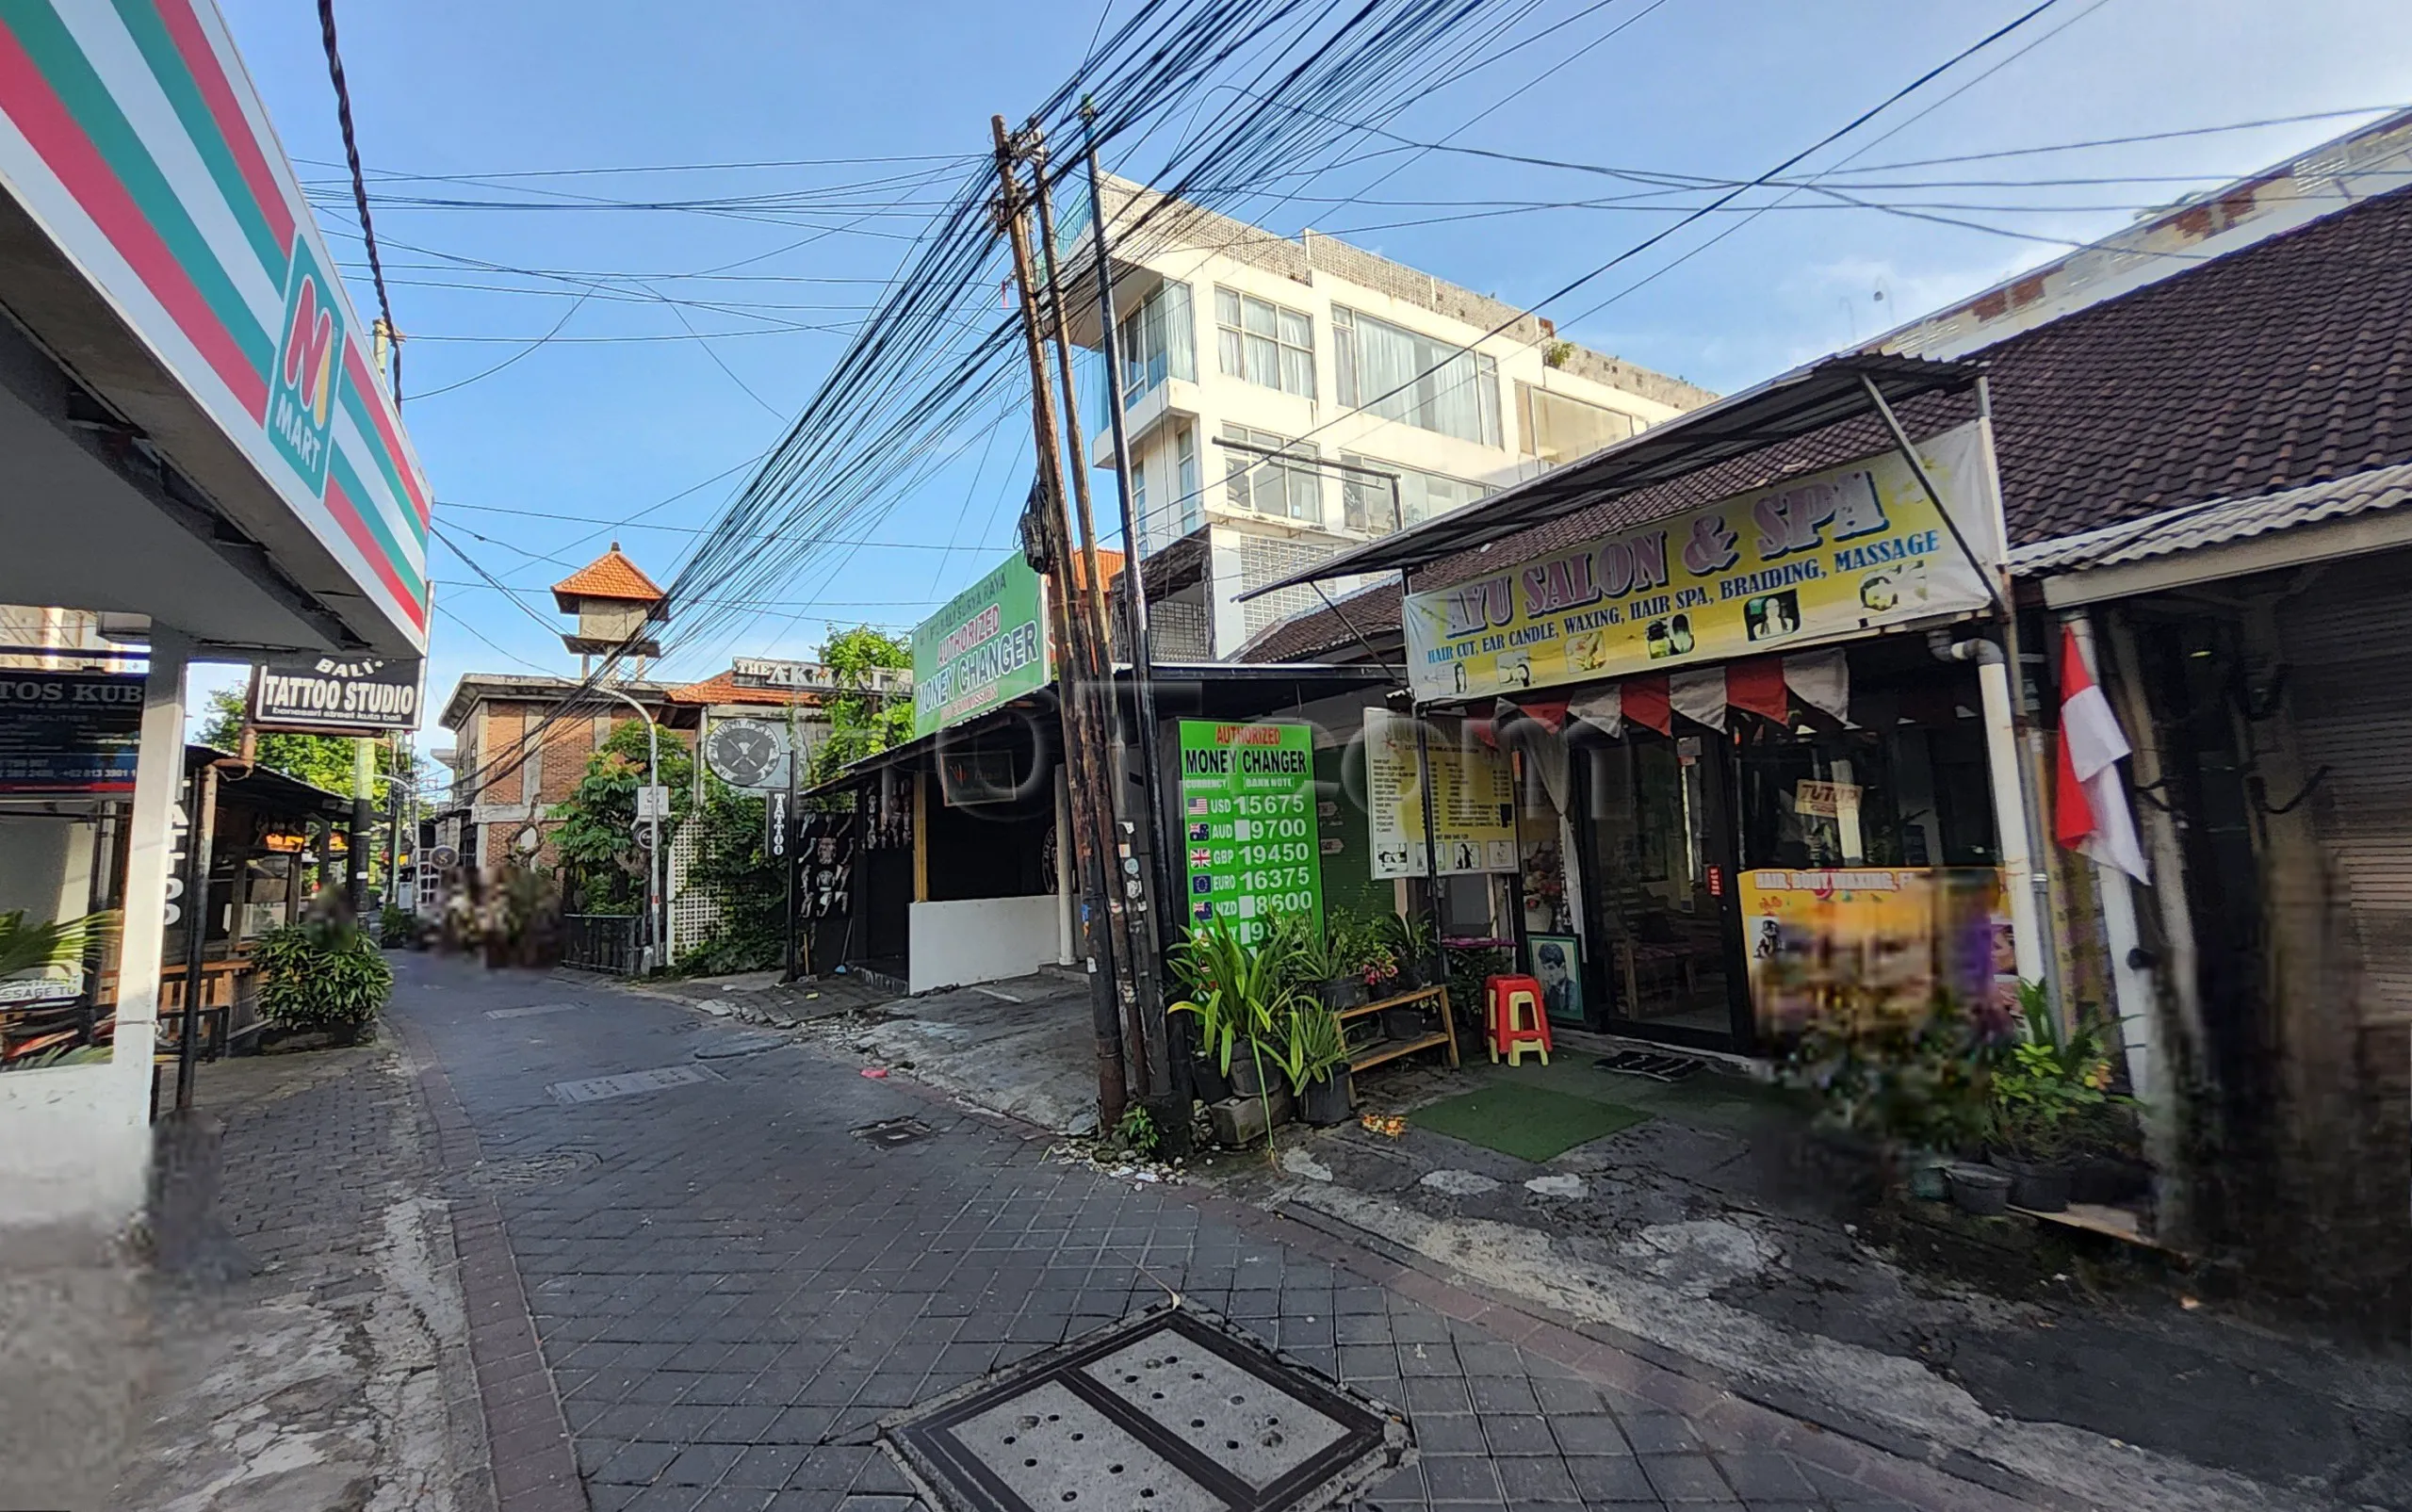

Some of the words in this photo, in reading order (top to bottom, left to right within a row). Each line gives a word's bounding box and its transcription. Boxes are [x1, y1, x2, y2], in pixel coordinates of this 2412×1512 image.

[275, 393, 321, 473] MART
[1446, 575, 1513, 640] AYU
[1522, 528, 1670, 620] SALON
[1682, 513, 1740, 577] &
[1753, 471, 1890, 562] SPA
[1427, 646, 1454, 664] HAIR
[1457, 642, 1479, 658] CUT,
[1482, 636, 1506, 652] EAR
[1508, 624, 1560, 646] CANDLE,
[1564, 607, 1626, 634] WAXING,
[1630, 598, 1670, 620] HAIR
[1676, 587, 1714, 610] SPA,
[1833, 529, 1941, 574] MASSAGE
[937, 603, 1001, 666] AUTHORIZED
[737, 661, 769, 675] THE
[917, 663, 955, 716] MONEY
[958, 620, 1039, 694] CHANGER
[266, 675, 341, 710] TATTOO
[344, 682, 415, 715] STUDIO
[1215, 724, 1281, 745] AUTHORIZED
[1185, 749, 1237, 773] MONEY
[1242, 750, 1308, 773] CHANGER
[1211, 798, 1231, 813] USD
[1233, 794, 1305, 815] 15675
[774, 793, 787, 855] TATTOO
[1212, 823, 1232, 839] AUD
[1250, 819, 1307, 839] 9700
[164, 780, 190, 925] ATTOO
[1214, 850, 1234, 865] GBP
[1238, 842, 1310, 866] 19450
[1213, 875, 1236, 891] EURO
[1239, 867, 1310, 891] 16375
[1215, 901, 1237, 917] NZD
[1256, 891, 1312, 916] 8600
